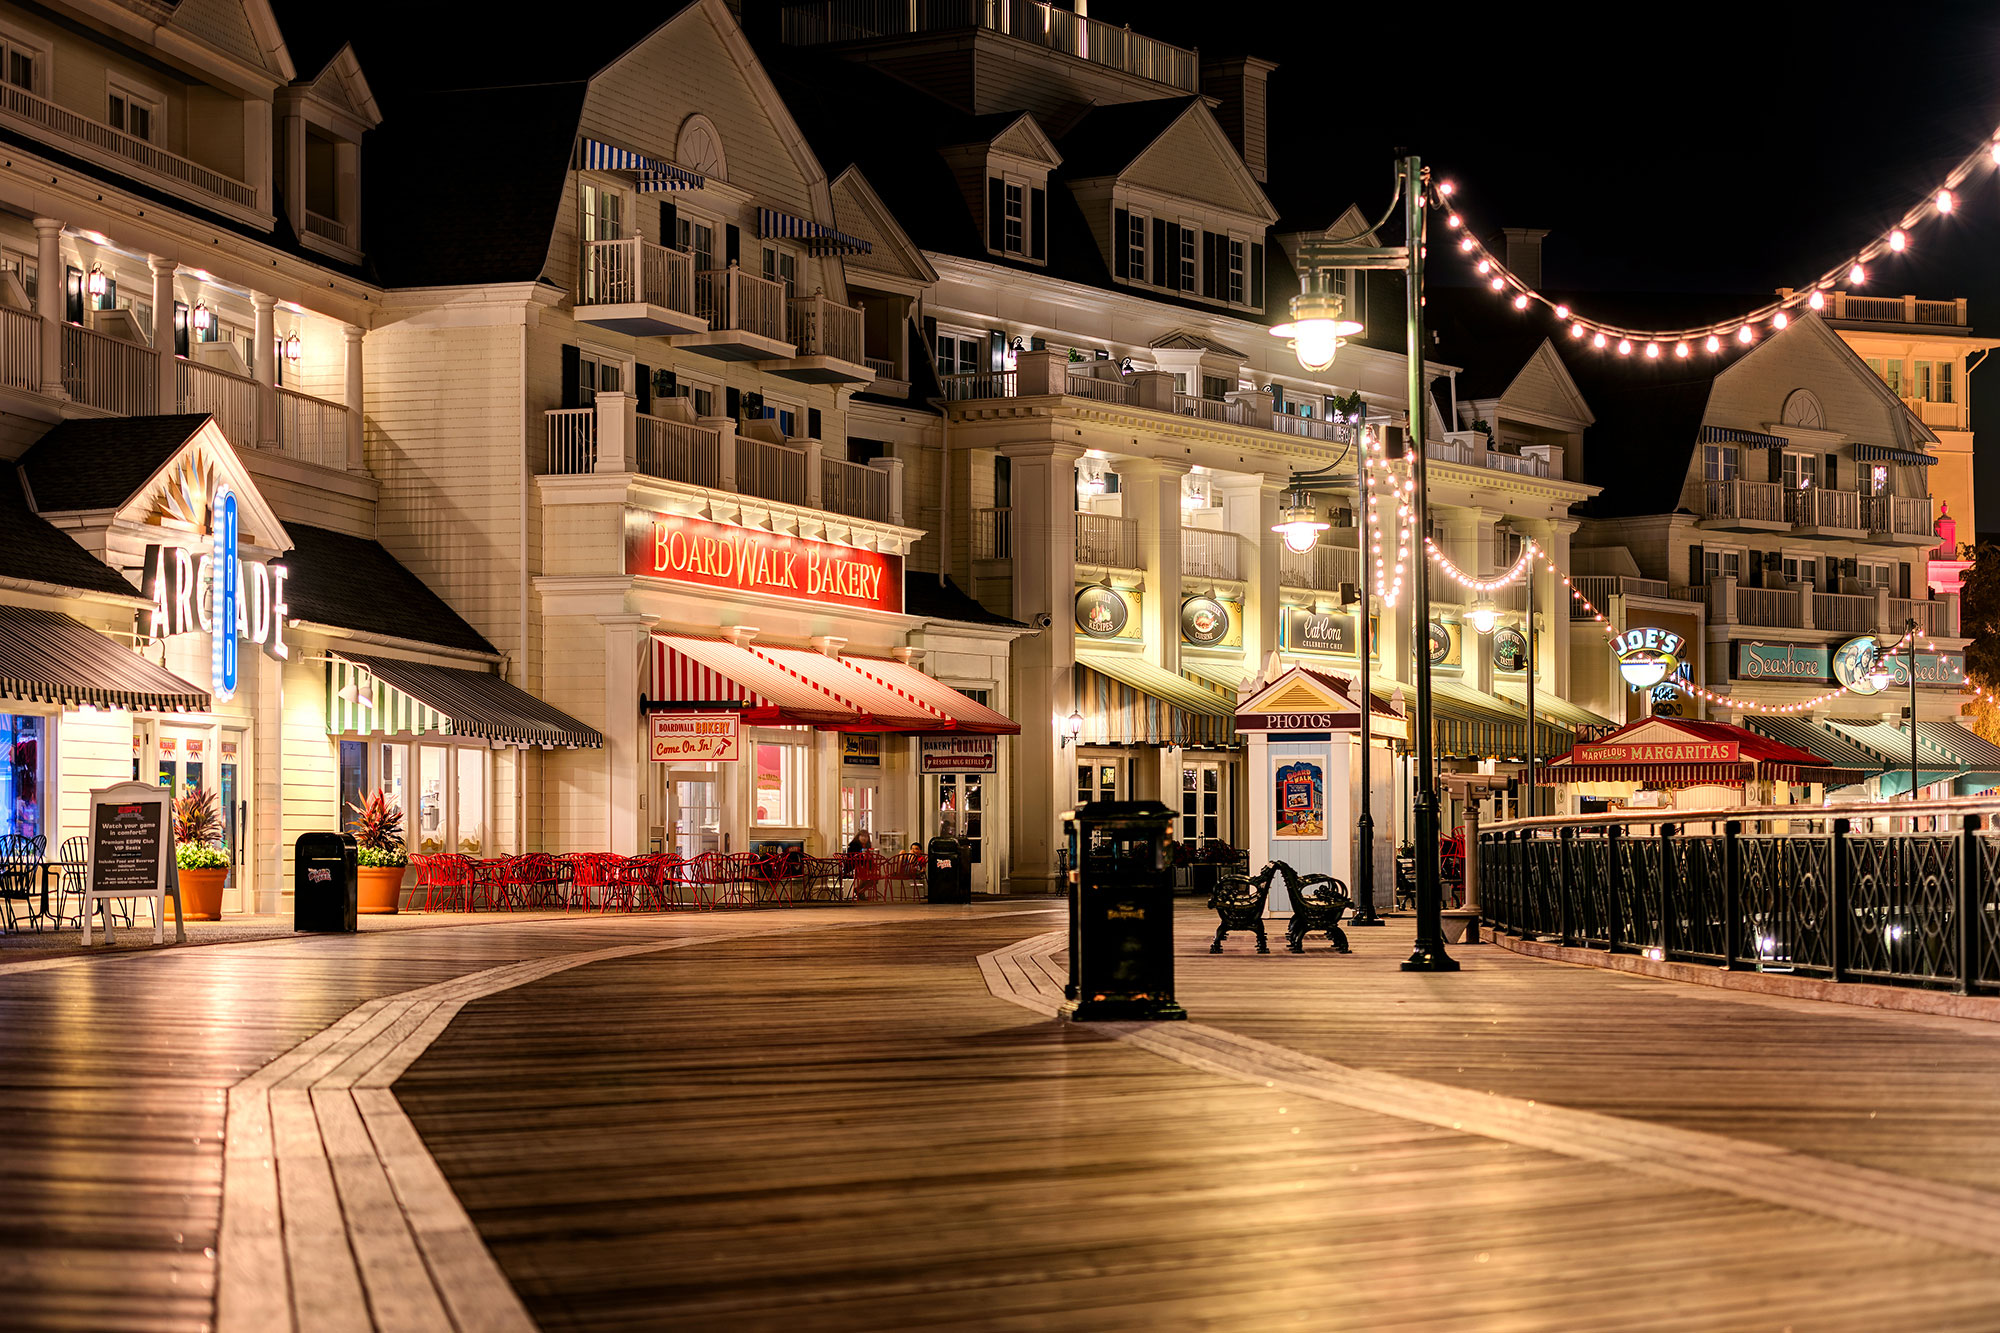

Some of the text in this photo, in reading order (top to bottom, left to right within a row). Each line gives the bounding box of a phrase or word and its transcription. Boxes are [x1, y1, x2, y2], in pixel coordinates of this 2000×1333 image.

[804, 547, 882, 601] BAKERY
[147, 543, 289, 661] ARCADE
[1088, 620, 1114, 632] RECIPES
[1302, 640, 1329, 649] CELEBRITY
[1615, 628, 1679, 657] JOE'S
[1747, 641, 1819, 679] Seashore
[658, 721, 730, 735] BOARDWALK BAKERY
[1266, 714, 1332, 728] PHOTOS
[656, 739, 713, 756] Come On In!
[924, 737, 992, 754] BAKERY FOUNTAIN
[1581, 745, 1730, 761] MARVELOUS MARGARITAS
[932, 758, 952, 766] RESORT
